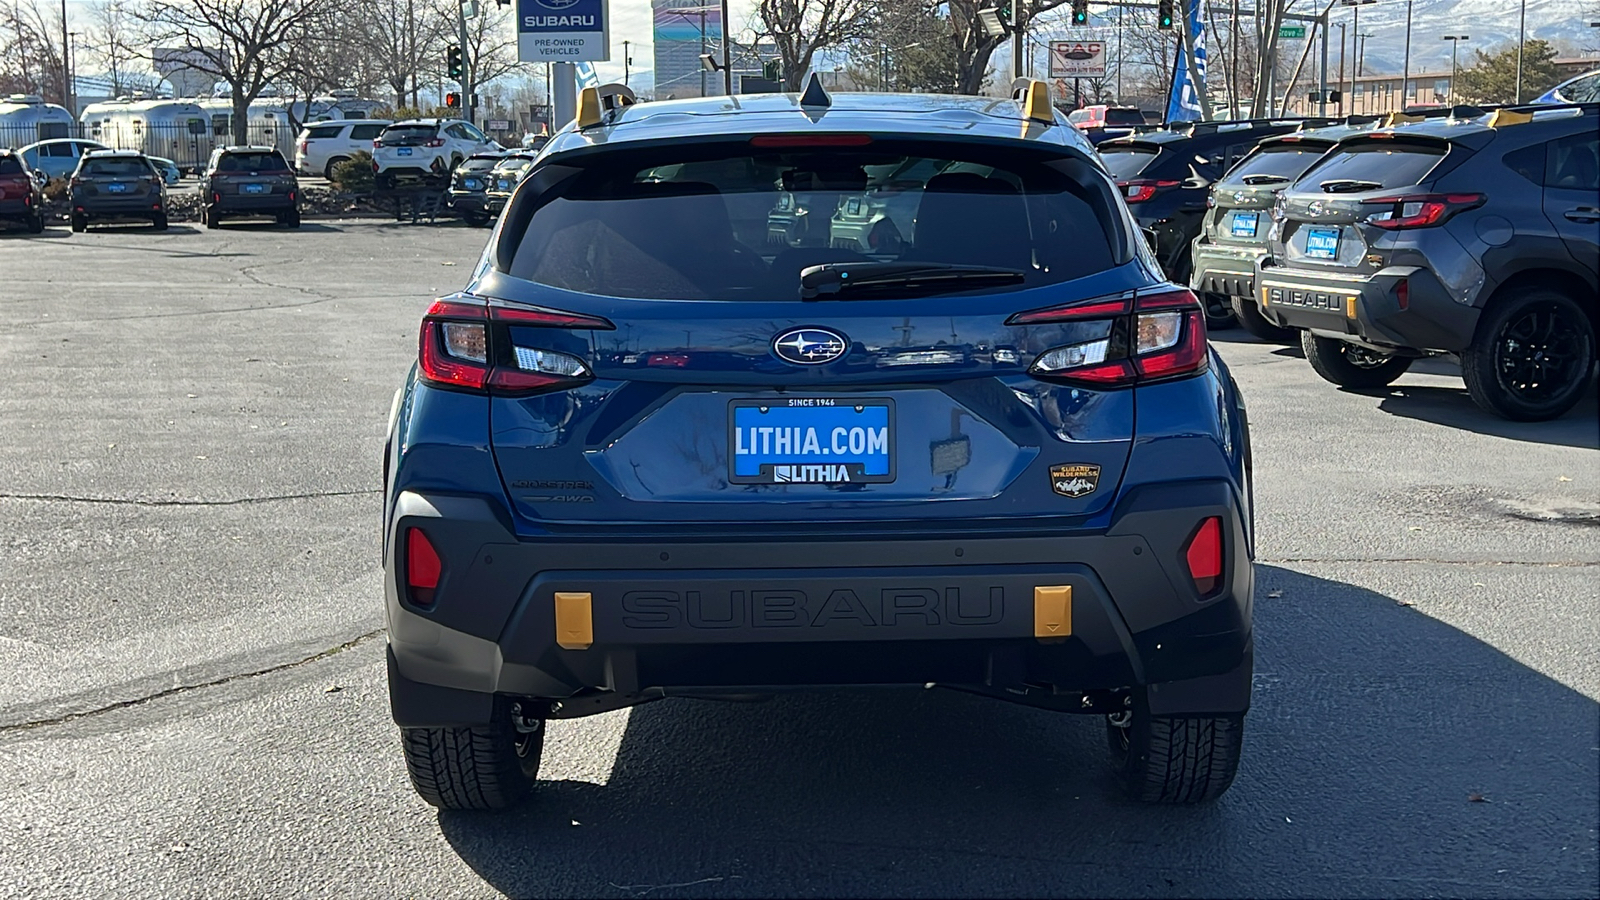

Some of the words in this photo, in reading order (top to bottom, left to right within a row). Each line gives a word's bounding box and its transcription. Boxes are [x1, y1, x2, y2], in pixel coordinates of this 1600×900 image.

[524, 15, 595, 27] SUBARU
[534, 39, 585, 47] PRE-OWNED
[1057, 44, 1101, 53] CAC
[1271, 288, 1341, 311] SUBARU
[788, 399, 814, 407] SINCE
[816, 399, 835, 407] 1946
[735, 427, 888, 455] LITHIA.COM
[791, 465, 851, 482] LITHIA
[511, 480, 595, 490] CROSSTREK
[621, 586, 1005, 630] SUBARU
